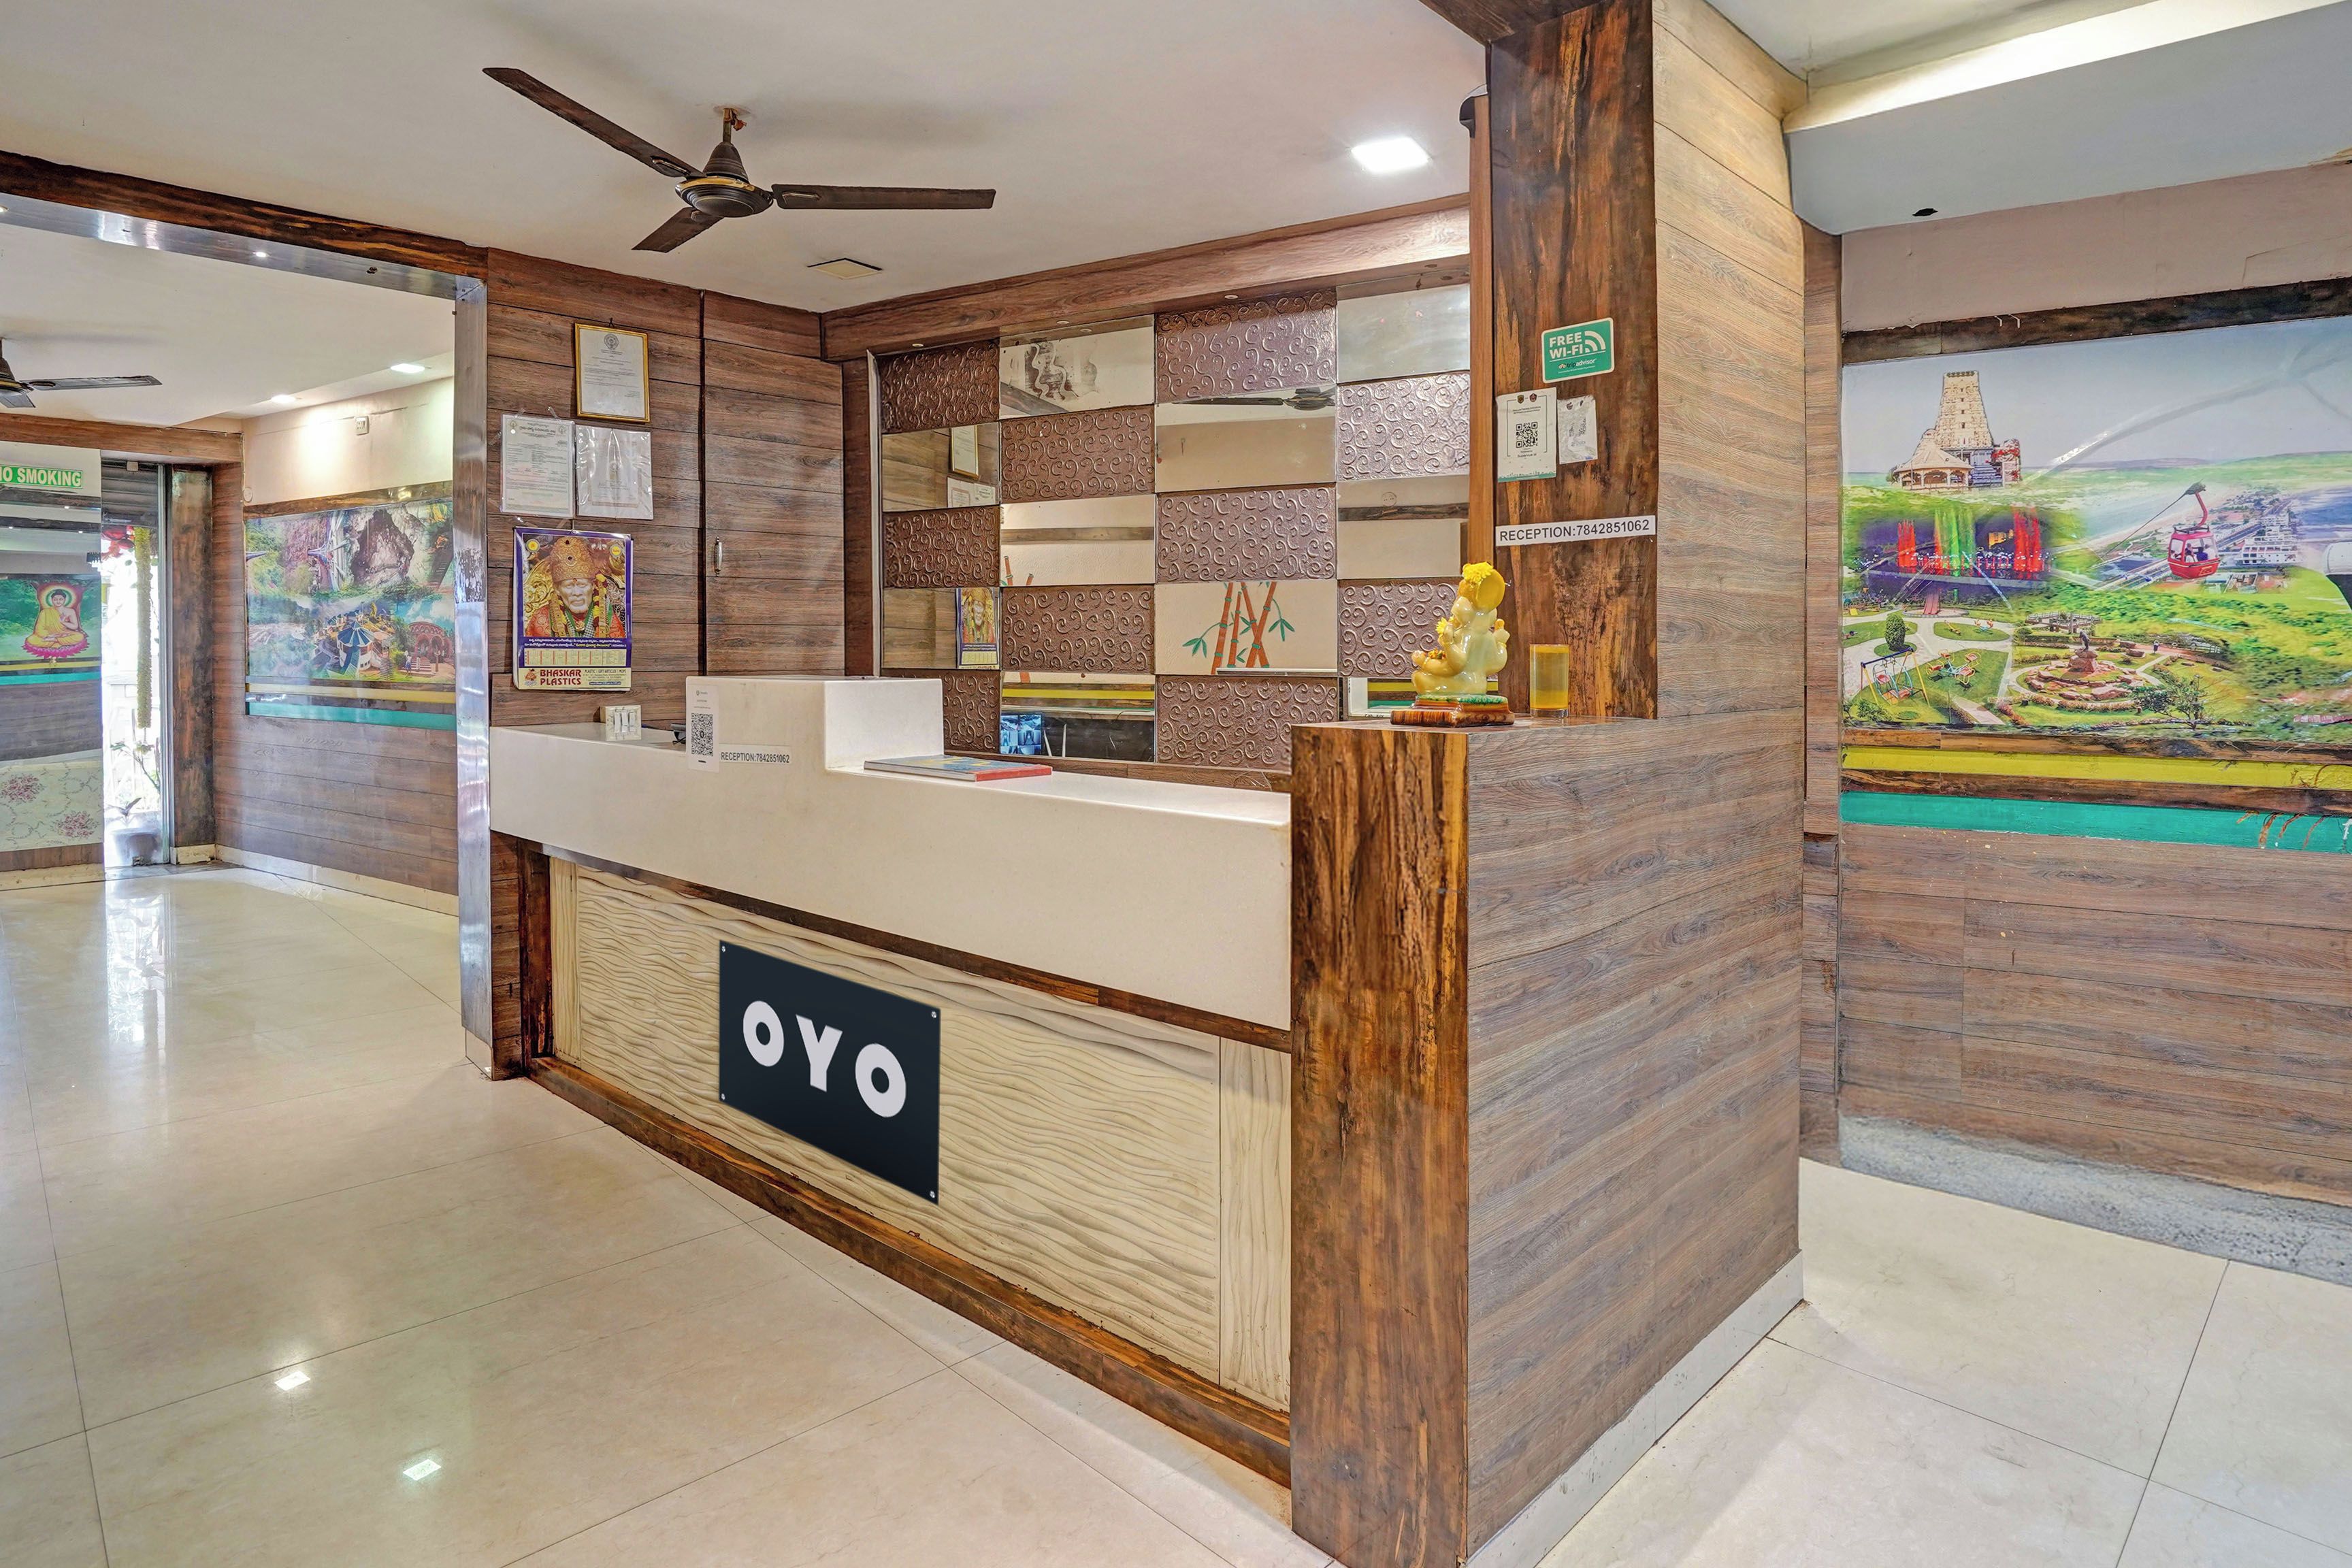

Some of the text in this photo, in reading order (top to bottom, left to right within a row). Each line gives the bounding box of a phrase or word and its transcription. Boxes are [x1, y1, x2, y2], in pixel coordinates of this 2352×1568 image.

[1549, 332, 1582, 348] FREE
[1549, 344, 1583, 359] WI-FI
[1567, 359, 1596, 368] tripadvisor
[17, 468, 81, 486] SMOKING
[1500, 519, 1650, 541] RECEPTION:7842851062
[540, 669, 581, 677] BHASKAR
[540, 678, 581, 686] PLASTICS
[721, 752, 790, 764] RECEPTION:7842851062
[742, 1000, 906, 1117] OYO
